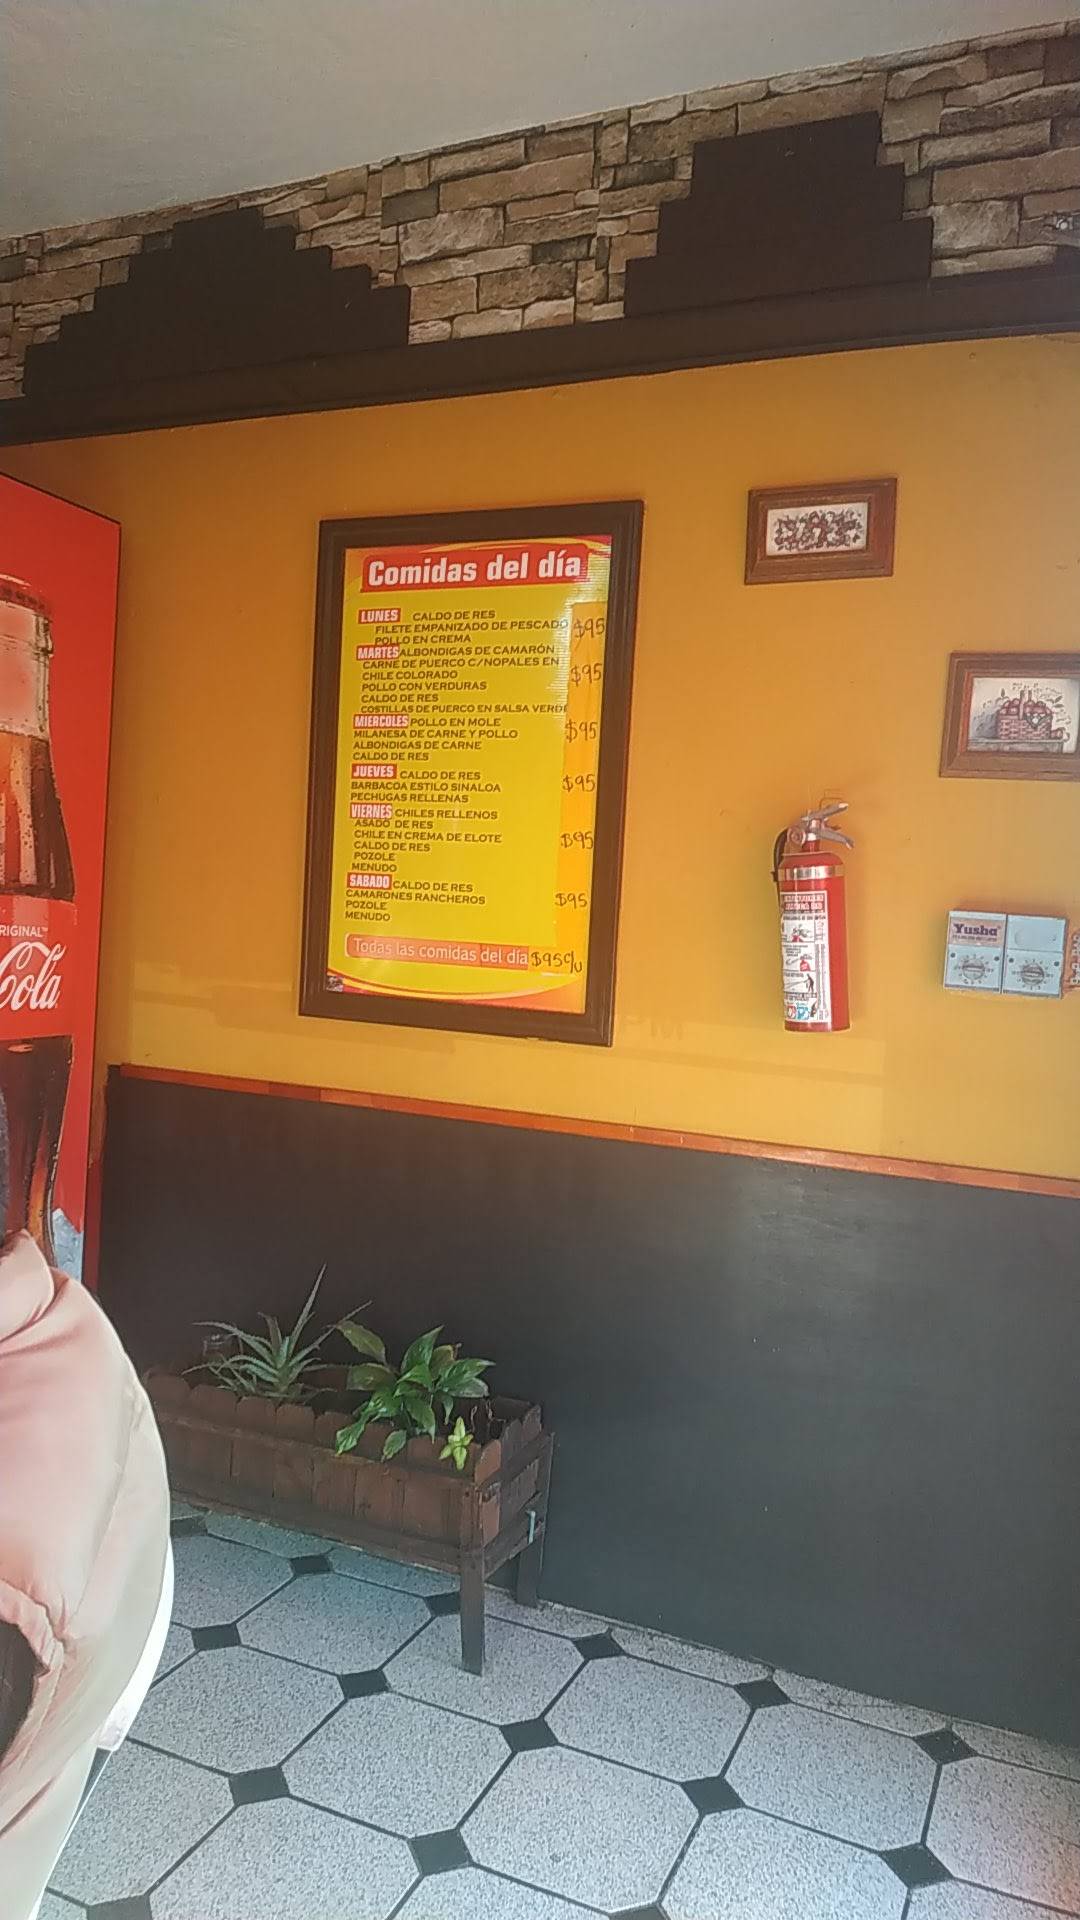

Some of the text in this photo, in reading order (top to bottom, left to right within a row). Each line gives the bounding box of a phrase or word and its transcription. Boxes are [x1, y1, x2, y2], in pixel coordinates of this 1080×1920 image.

[368, 550, 581, 586] Comidas del día
[361, 609, 495, 622] LUNES CALDO DE RES
[375, 620, 568, 634] FILETE EMPANIZADO DE PESCADO
[573, 617, 605, 638] $95
[375, 634, 471, 645] POLLO EN CREMA
[358, 644, 555, 660] MARTES ALBONDIGAS DE CAMARÓN
[363, 657, 559, 669] CARNE DE PUERCO C/NOPALES EN
[362, 670, 458, 680] CHILE COLORADO
[570, 662, 603, 687] $95
[362, 681, 487, 691] POLLO CON VERDURAS
[361, 693, 439, 703] CALDO DE RES
[361, 705, 414, 713] COSTILLAS
[416, 705, 430, 713] DE
[432, 704, 475, 713] PUERCO
[477, 704, 492, 712] EN
[494, 704, 529, 712] SALSA
[354, 715, 501, 728] MIERCOLES POLLO EN MOLE
[354, 729, 518, 738] MILANESA DE CARNE Y POLLO
[565, 719, 598, 743] $95
[353, 741, 482, 750] ALBONDIGAS DE CARNE
[353, 752, 429, 760] CALDO DE RES
[353, 765, 481, 780] JUEVES CALDO DE RES
[351, 781, 501, 792] BARBACOA ESTILO SINALOA
[562, 774, 596, 792] $95
[351, 792, 468, 802] PECHUGAS RELLENAS
[351, 804, 498, 819] VIERNES CHILES RELLENOS
[354, 819, 433, 829] ASADO DE RES
[354, 830, 502, 842] CHILE EN CREMA DE ELOTE
[560, 831, 594, 849] $95
[353, 841, 431, 852] CALDO DE RES
[353, 852, 395, 861] POZOLE
[352, 863, 397, 872] MENUDO
[349, 874, 473, 892] SABADO CALDO DE RES
[346, 890, 485, 904] CAMARONES RANCHEROS
[555, 892, 588, 909] $95
[346, 900, 387, 910] POZOLE
[345, 911, 390, 921] MENUDO
[953, 923, 997, 936] Yusha
[353, 937, 528, 964] Todas las comidas del día
